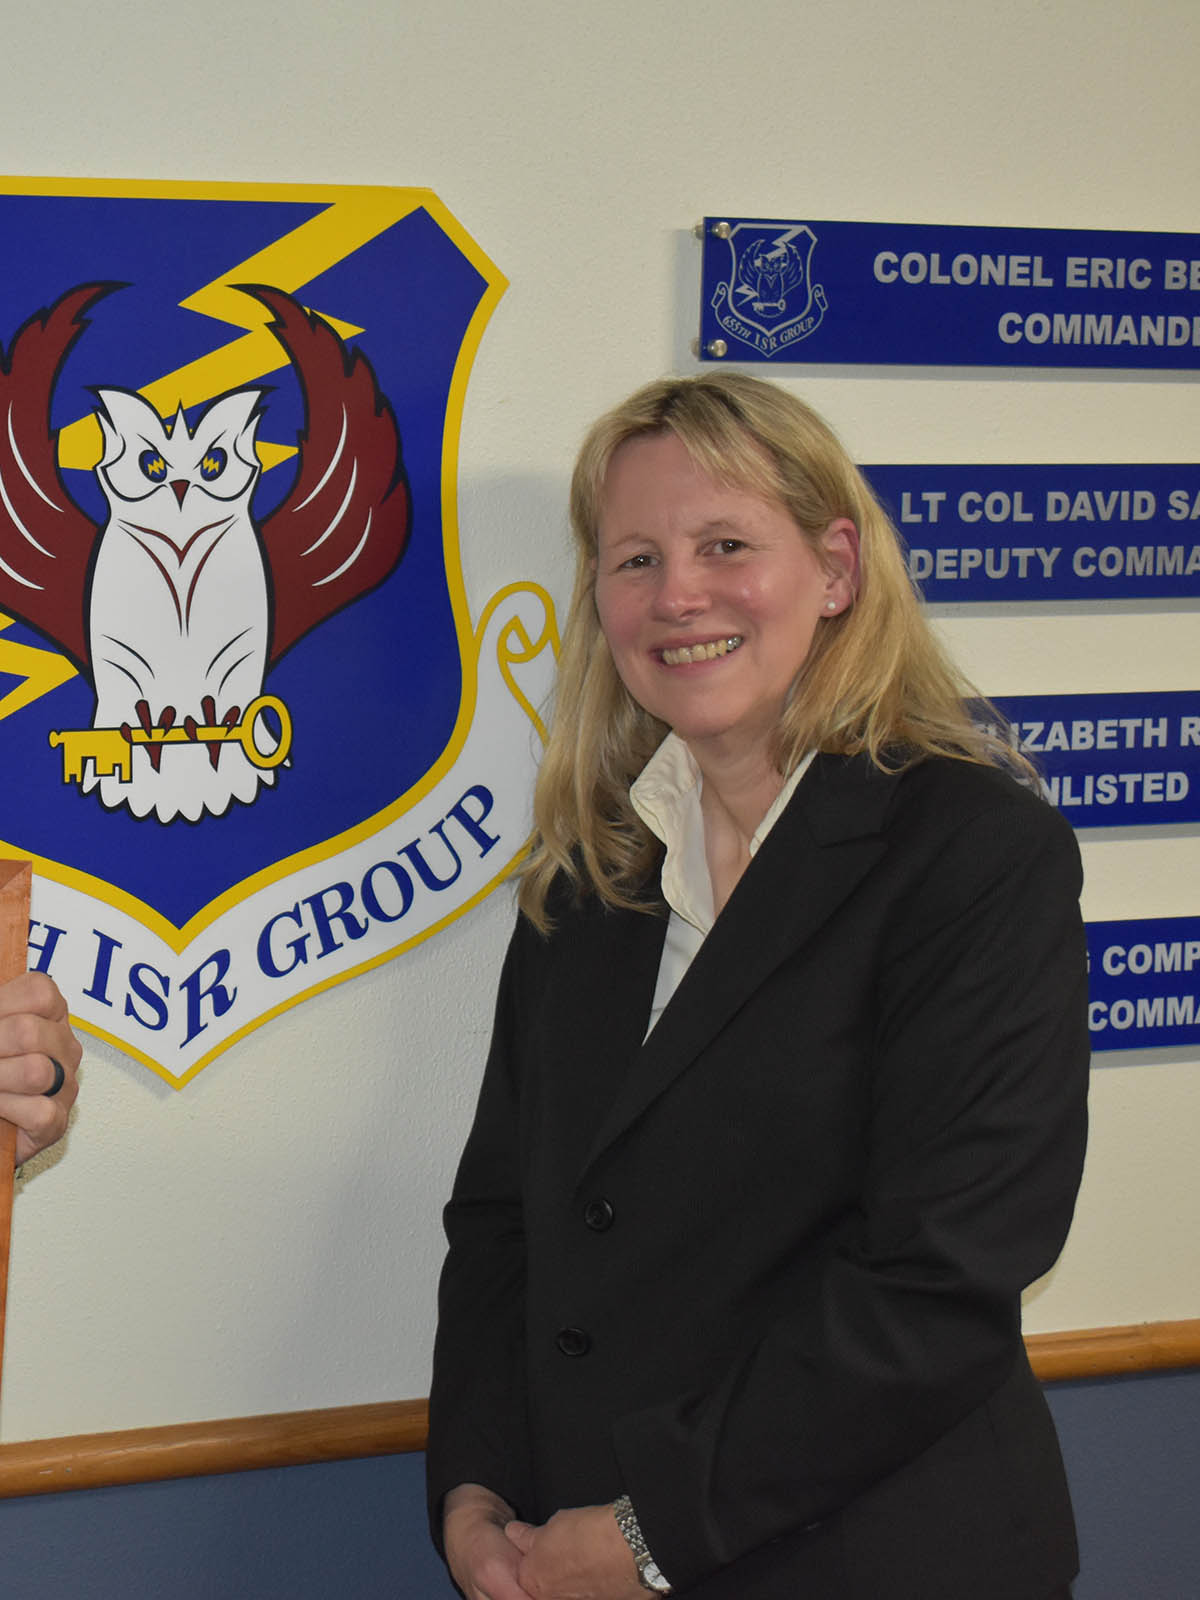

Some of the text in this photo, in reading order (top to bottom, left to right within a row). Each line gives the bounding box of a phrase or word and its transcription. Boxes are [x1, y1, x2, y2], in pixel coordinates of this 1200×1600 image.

[873, 251, 1053, 288] COLONEL
[1066, 256, 1153, 290] ERIC
[754, 333, 778, 350] ISR
[780, 316, 814, 343] GROUP
[901, 492, 946, 523] LT
[958, 491, 1033, 523] COL
[1046, 490, 1156, 522] DAVID
[909, 547, 1061, 580] DEPUTY
[1015, 771, 1189, 807] NLISTED
[82, 928, 239, 1049] ISR
[255, 783, 501, 981] GROUP
[1088, 996, 1200, 1032] COMM
